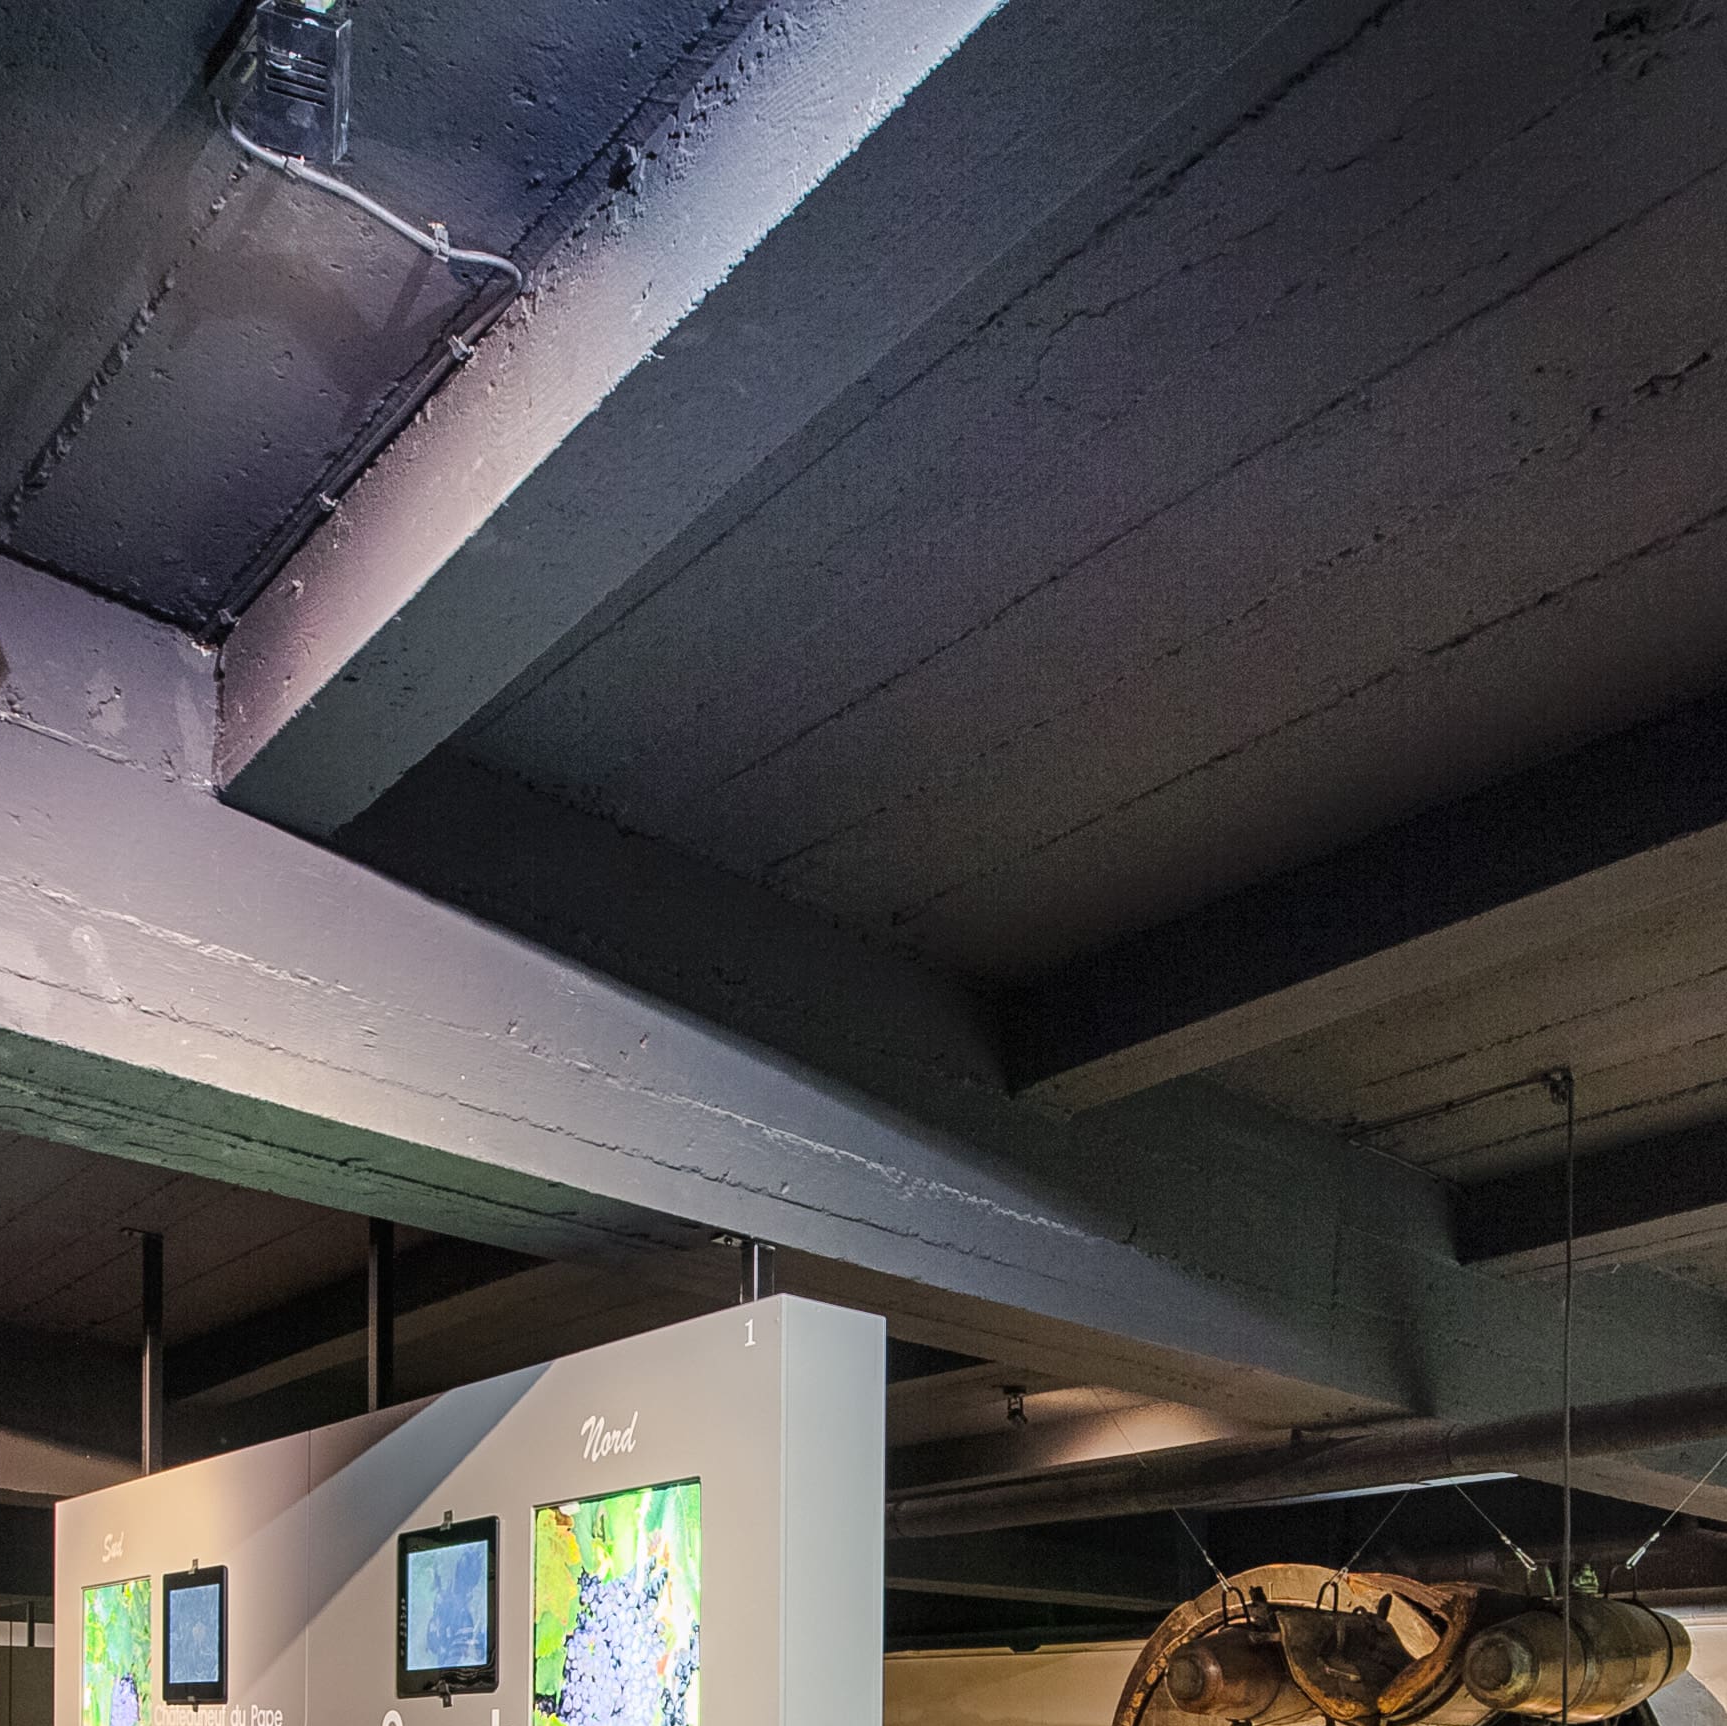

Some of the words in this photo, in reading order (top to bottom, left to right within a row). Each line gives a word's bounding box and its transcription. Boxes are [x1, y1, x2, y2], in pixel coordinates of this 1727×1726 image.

[744, 1318, 756, 1347] 1
[580, 1411, 639, 1463] Nord
[102, 1531, 124, 1563] Sud
